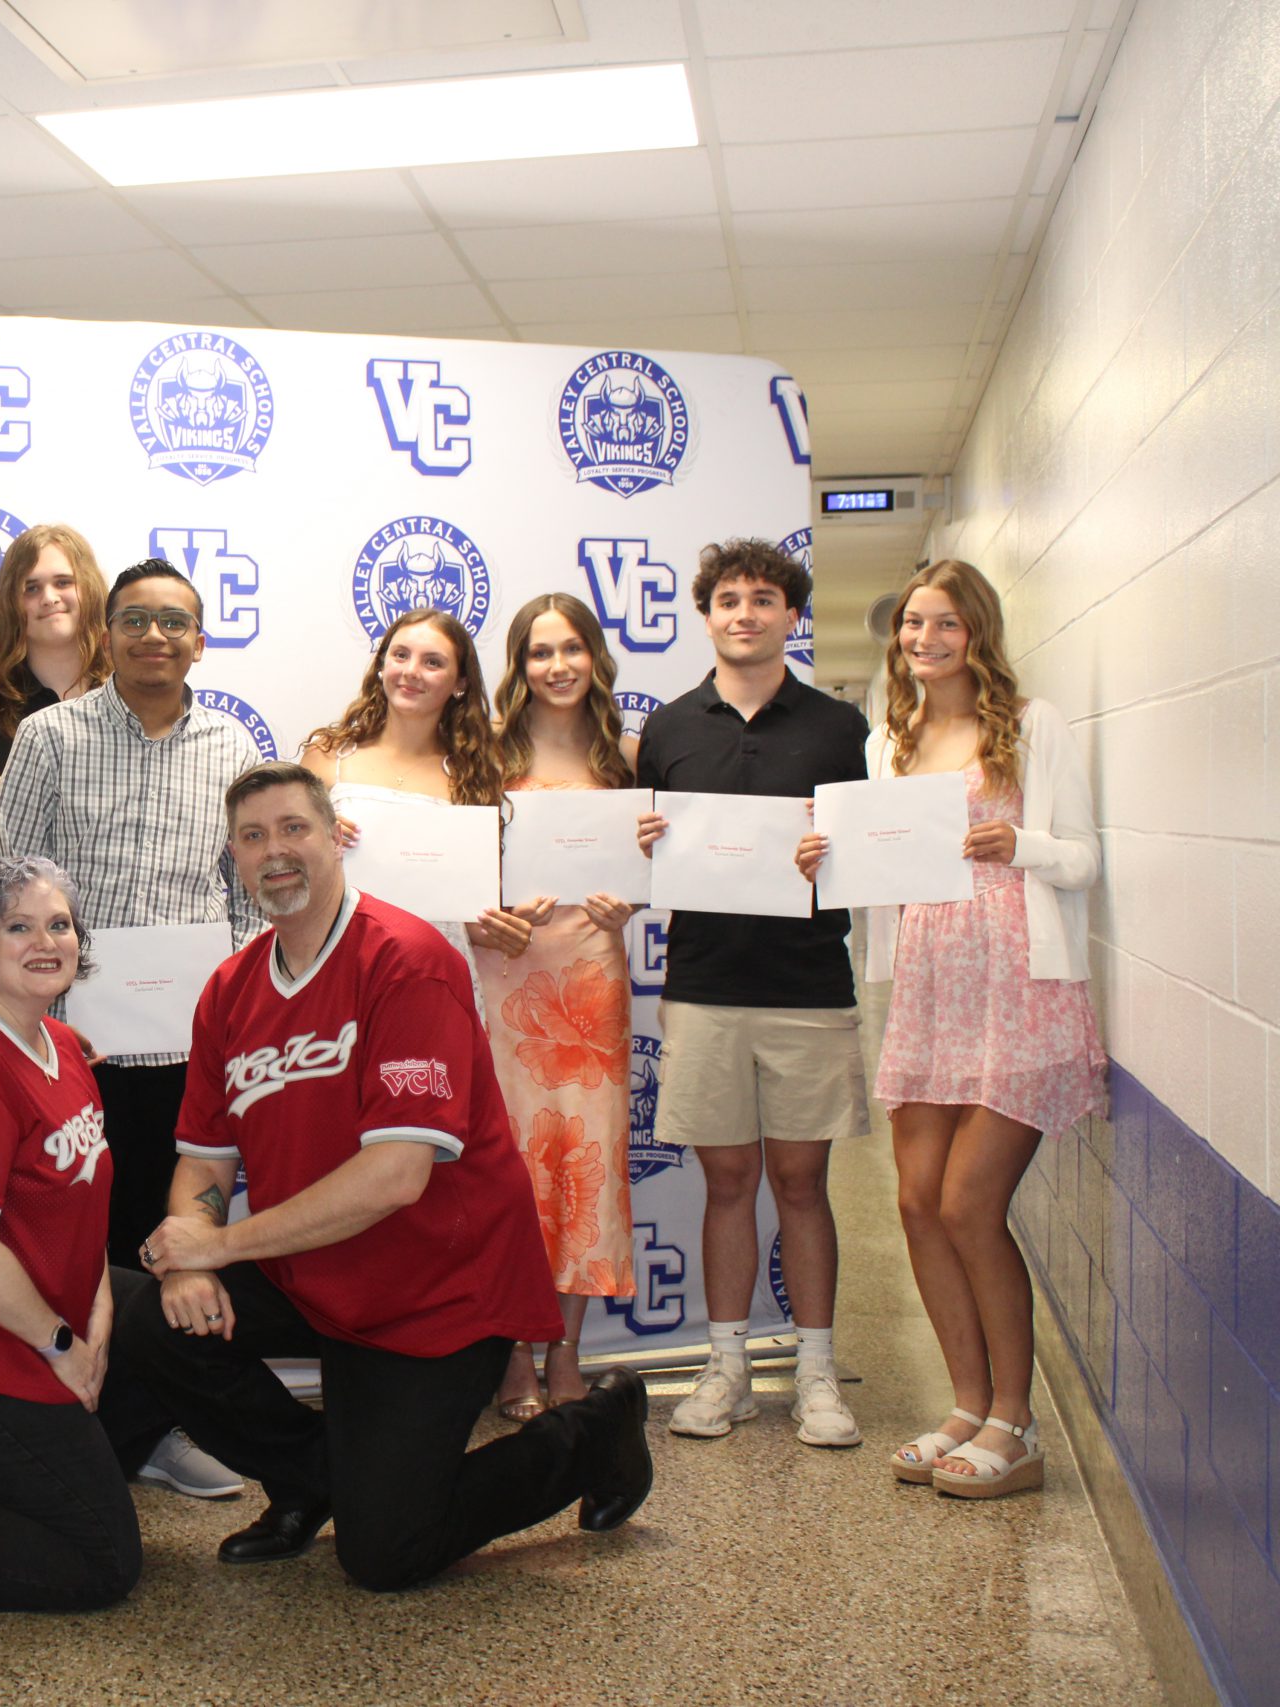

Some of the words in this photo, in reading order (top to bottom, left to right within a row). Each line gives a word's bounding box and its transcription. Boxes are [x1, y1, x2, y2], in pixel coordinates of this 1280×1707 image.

[131, 367, 157, 451] VALLEY
[149, 333, 236, 366] CENTRAL
[240, 356, 272, 455] SCHOOLS
[366, 358, 470, 477] VC
[561, 386, 584, 465] VALLEY
[576, 353, 653, 384] CENTRAL
[658, 376, 686, 467] SCHOOLS
[168, 424, 235, 450] VIKINGS
[594, 440, 654, 464] VIKINGS
[583, 467, 609, 476] LOYALTY
[637, 468, 667, 478] PROGRESS
[838, 493, 864, 509] 7:11
[355, 553, 379, 633] VALLEY
[371, 518, 454, 551] CENTRAL
[459, 540, 488, 636] SCHOOLS
[578, 538, 677, 652] VC
[646, 1152, 675, 1161] PROGRESS
